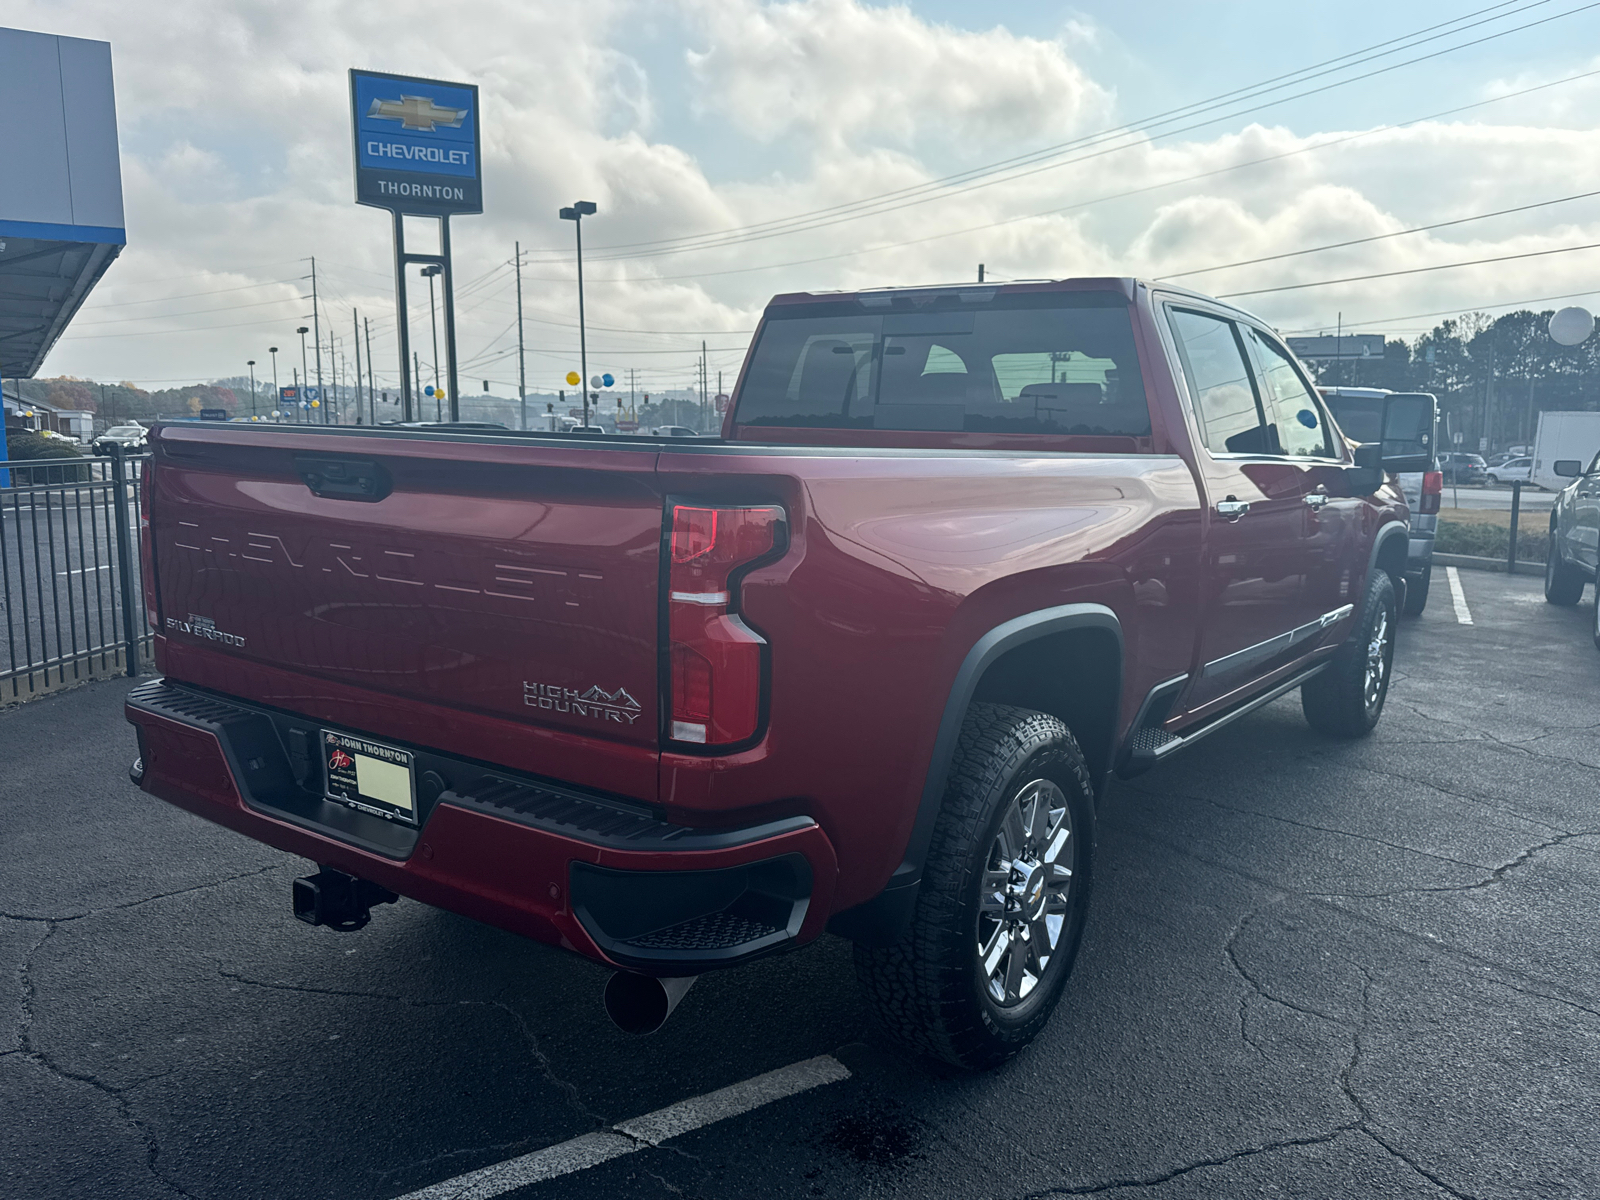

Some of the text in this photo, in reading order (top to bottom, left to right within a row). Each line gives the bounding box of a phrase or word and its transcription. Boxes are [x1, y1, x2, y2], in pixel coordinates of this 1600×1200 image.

[367, 141, 470, 165] CHEVROLET
[378, 180, 464, 200] THORNTON
[166, 617, 246, 648] SILVERADO
[523, 680, 579, 701] HIGH
[523, 694, 641, 725] COUNTRY
[340, 737, 408, 764] JOHN THORNTON
[357, 804, 384, 817] CHEVROLET
